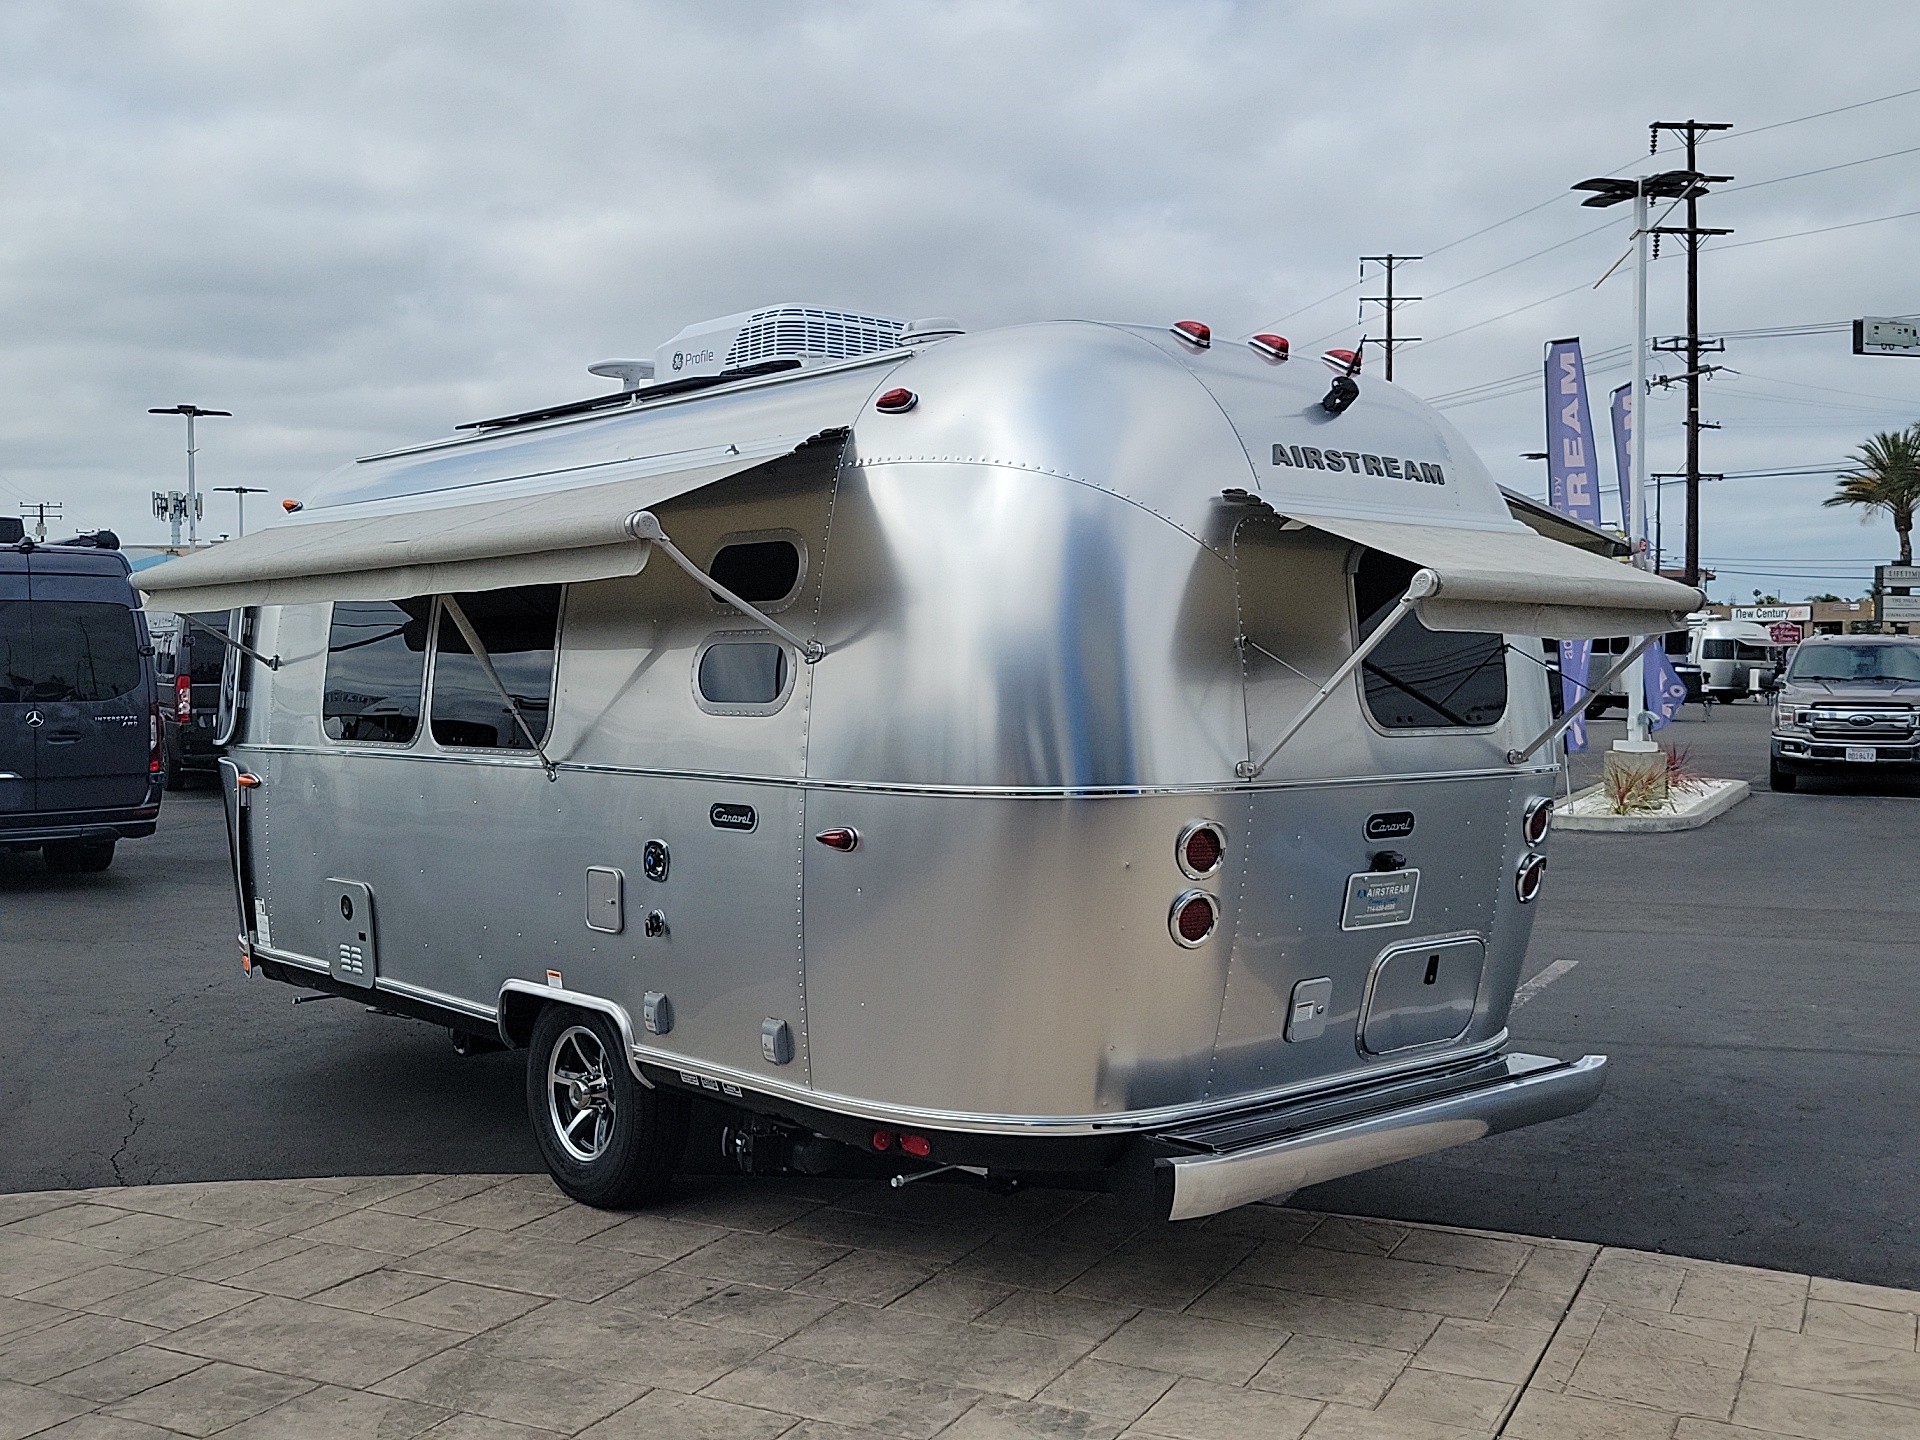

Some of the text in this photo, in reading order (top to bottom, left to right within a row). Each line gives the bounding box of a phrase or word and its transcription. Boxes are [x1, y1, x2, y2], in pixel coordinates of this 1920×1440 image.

[685, 350, 714, 366] Profile
[1272, 443, 1446, 486] AIRSTREAM
[1756, 608, 1790, 619] Century
[712, 807, 753, 824] Caravel
[1369, 817, 1412, 833] Caravel
[1366, 884, 1410, 898] AIRSTREAM
